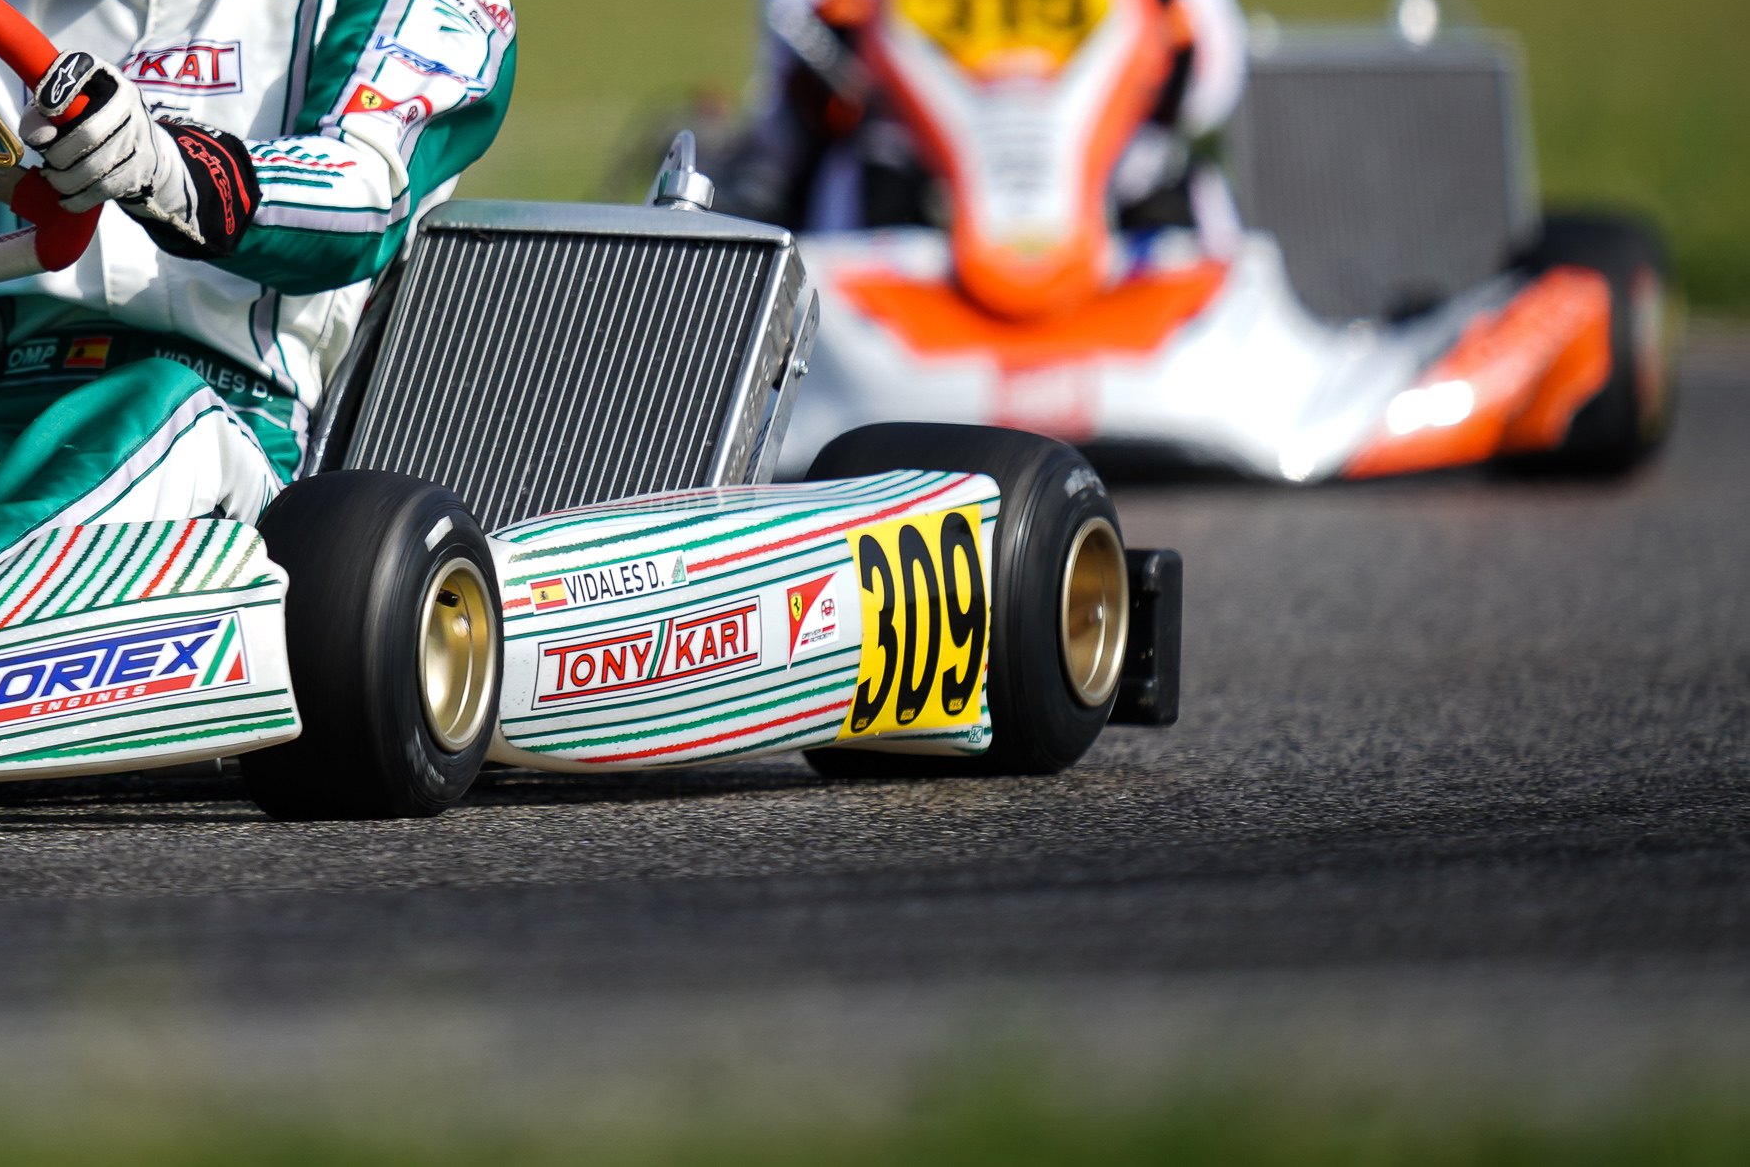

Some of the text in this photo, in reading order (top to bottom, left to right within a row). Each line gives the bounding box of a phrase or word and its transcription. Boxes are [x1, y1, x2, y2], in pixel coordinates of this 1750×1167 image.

[7, 344, 58, 369] OMP
[252, 380, 275, 403] D.
[563, 560, 666, 605] VIDALES D.
[850, 511, 988, 734] 309
[544, 603, 758, 692] TONY KART
[29, 683, 148, 717] ENGINES
